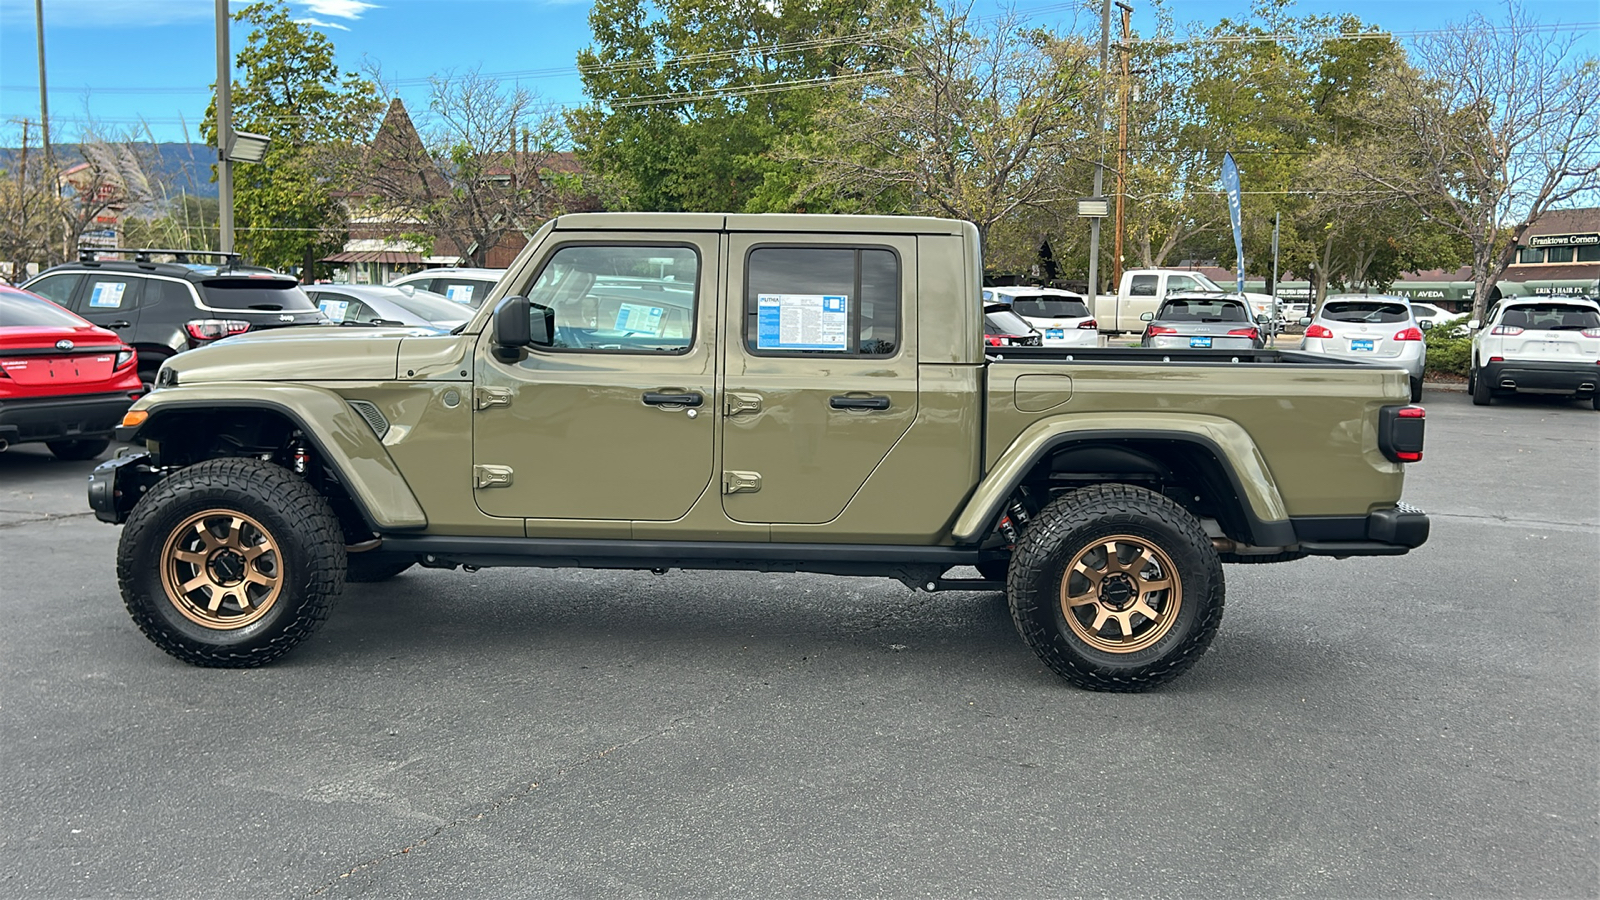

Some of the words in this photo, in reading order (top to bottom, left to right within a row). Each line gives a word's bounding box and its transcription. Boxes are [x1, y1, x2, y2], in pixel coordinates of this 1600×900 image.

[1532, 237, 1569, 245] Franktown
[1570, 235, 1599, 243] Corners
[1417, 290, 1444, 298] AVEDA
